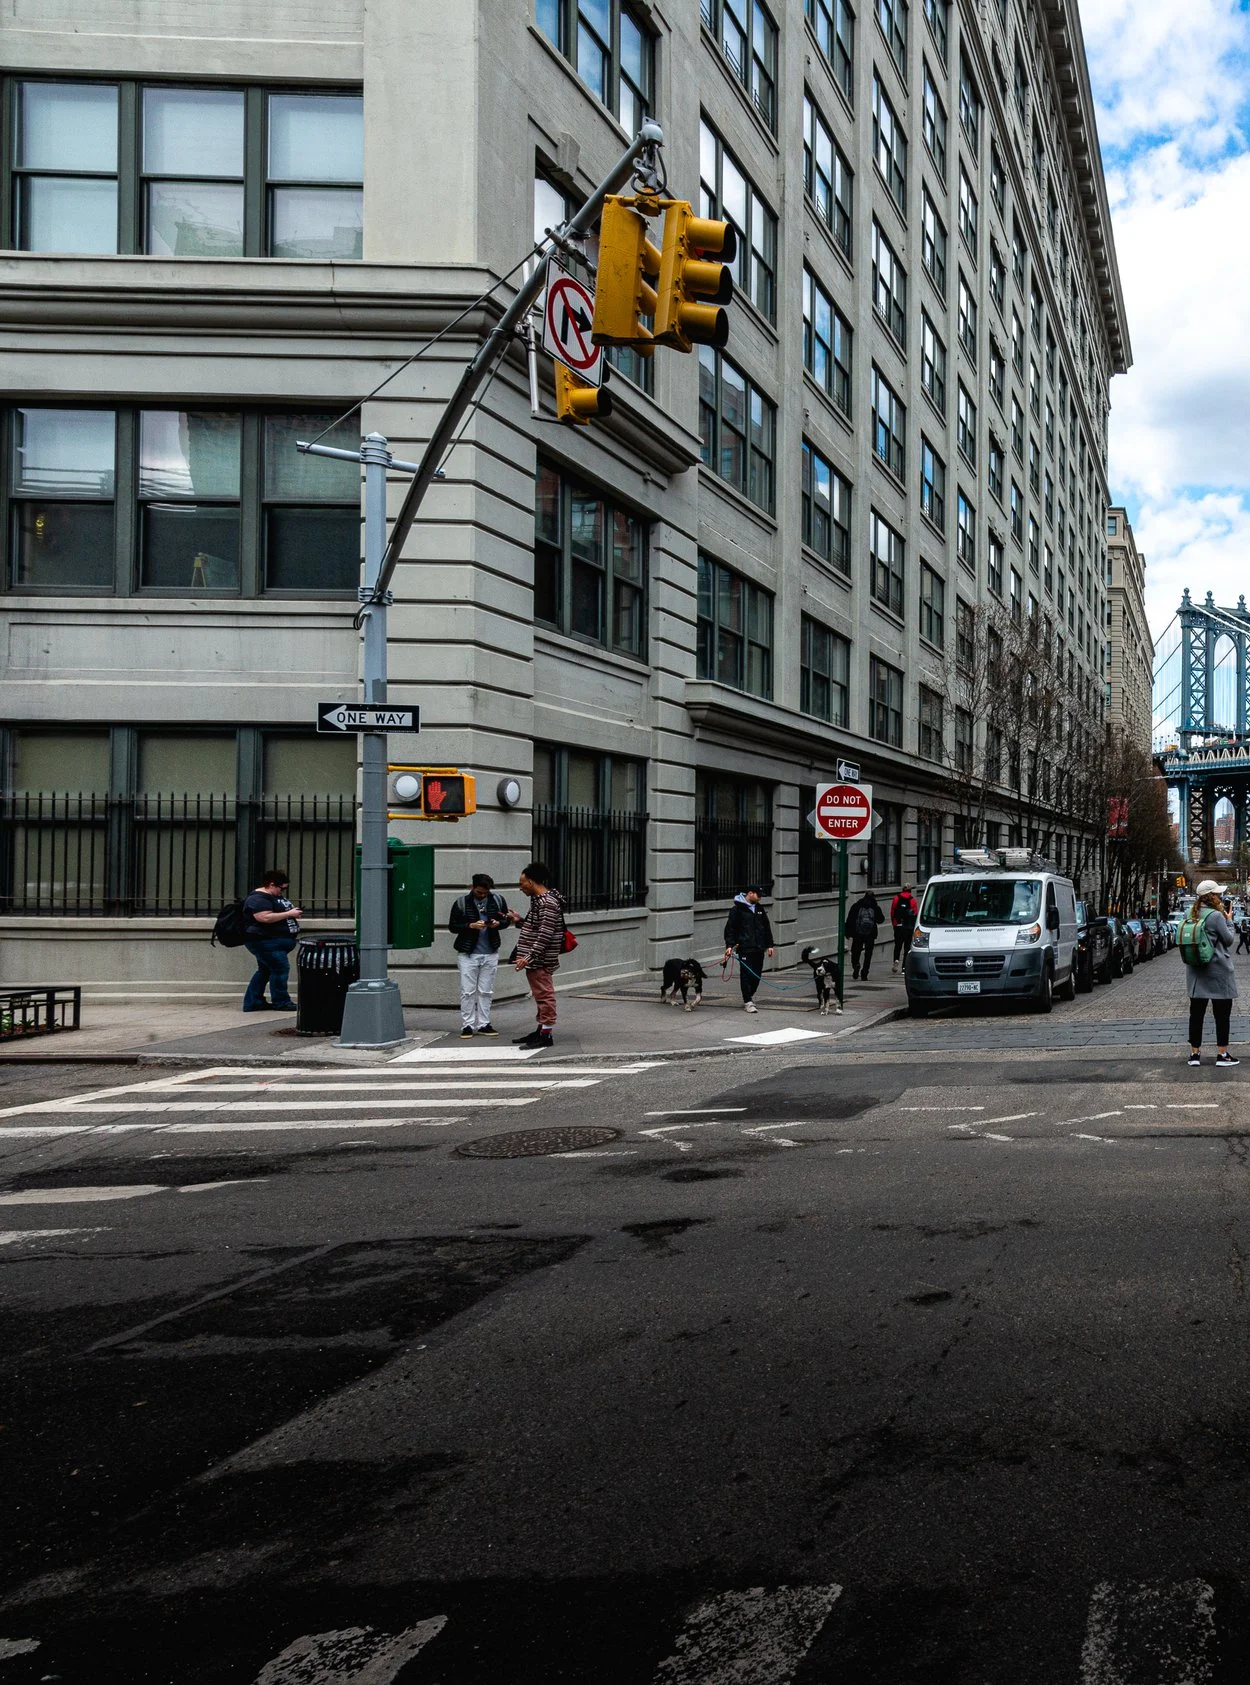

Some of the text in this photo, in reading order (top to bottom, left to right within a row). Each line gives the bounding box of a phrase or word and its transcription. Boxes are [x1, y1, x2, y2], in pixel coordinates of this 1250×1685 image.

[337, 712, 406, 725] ONE WAY
[826, 795, 861, 805] DO NOT
[828, 819, 858, 828] ENTER
